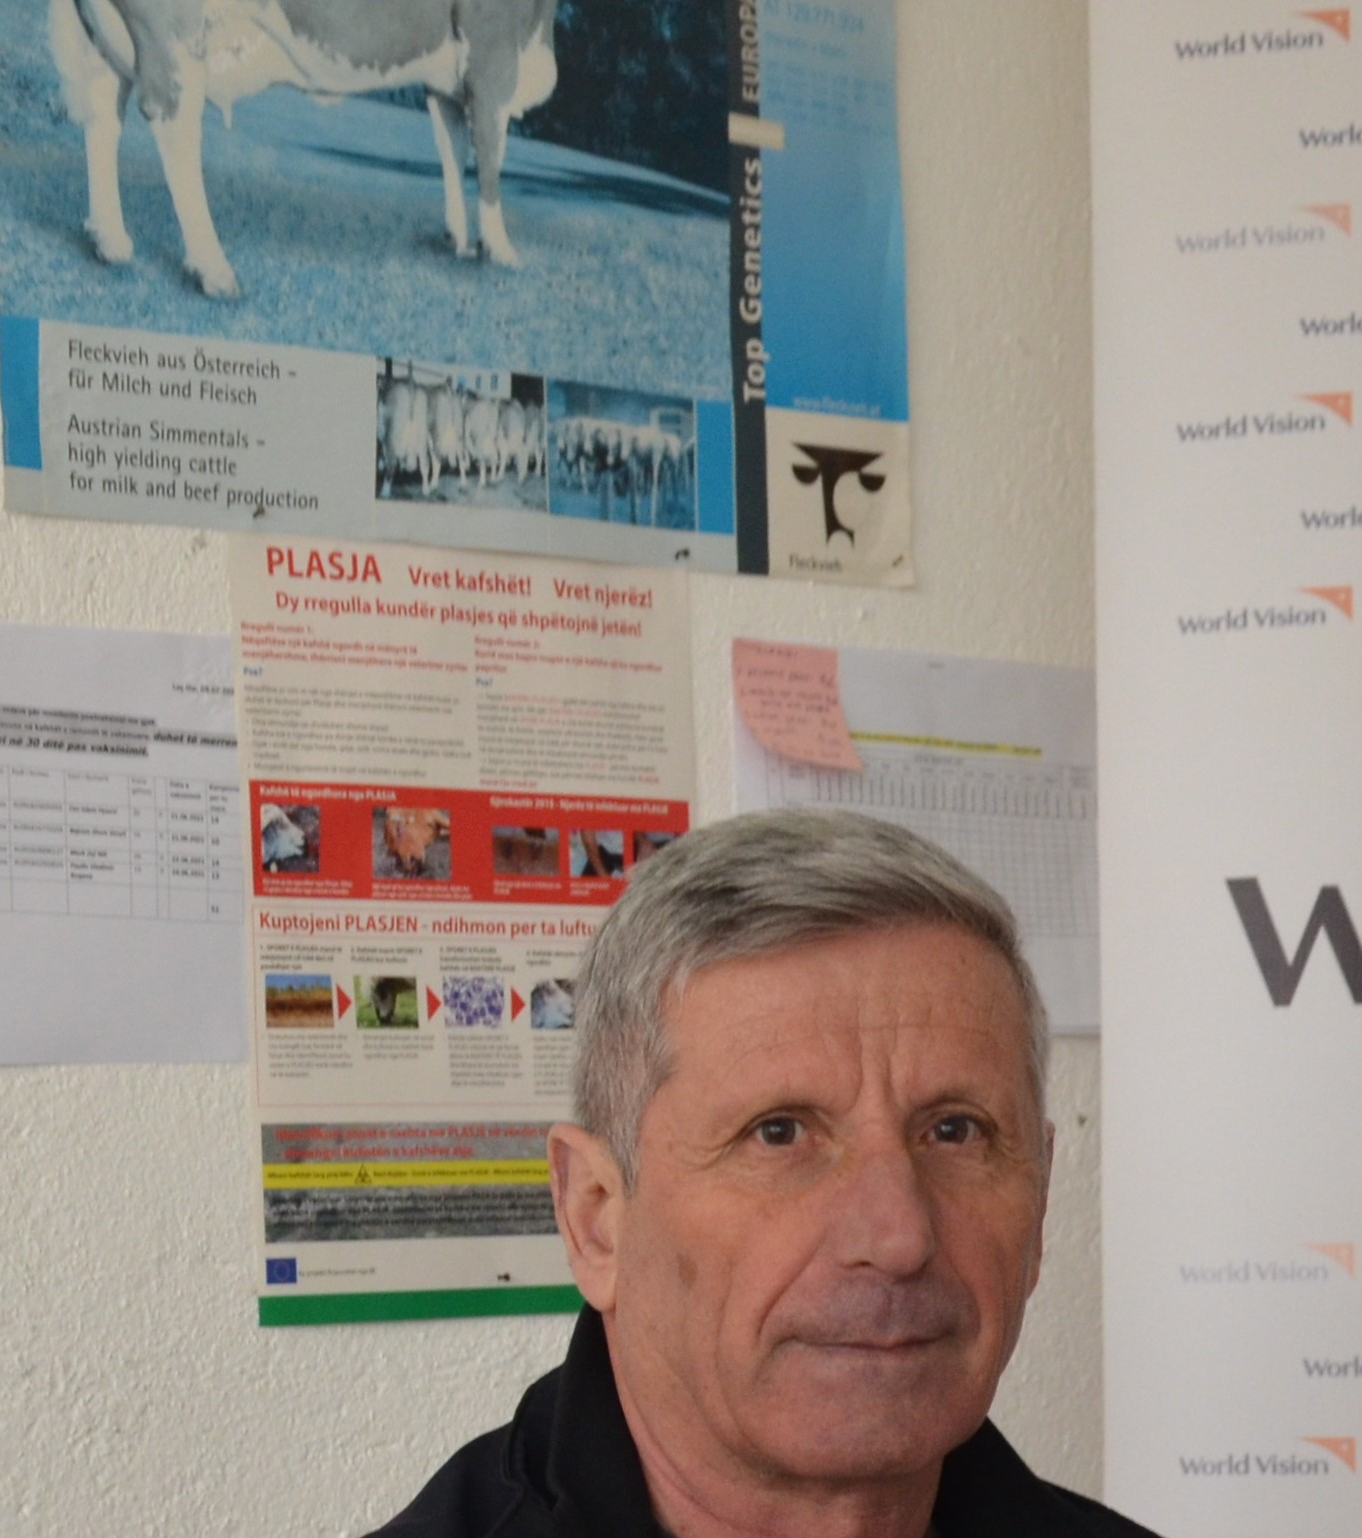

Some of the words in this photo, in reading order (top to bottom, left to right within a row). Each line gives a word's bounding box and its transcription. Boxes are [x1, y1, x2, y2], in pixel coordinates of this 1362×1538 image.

[740, 0, 760, 103] EUROP
[1175, 32, 1246, 60] World
[1251, 30, 1324, 52] Vision
[739, 157, 763, 325] Genetics
[68, 338, 149, 367] Fleckvieh
[157, 353, 186, 371] aus
[193, 349, 280, 380] Österreich
[743, 337, 771, 404] Top
[68, 368, 94, 390] für
[102, 371, 151, 396] Milch
[159, 380, 192, 399] und
[200, 380, 257, 406] Fleisch
[67, 413, 142, 439] Austrian
[149, 420, 249, 449] Simmentals
[68, 442, 106, 468] high
[114, 447, 181, 476] yielding
[189, 456, 237, 476] cattle
[69, 470, 94, 492] for
[102, 475, 138, 495] milk
[145, 479, 176, 499] and
[184, 480, 220, 502] beef
[226, 488, 319, 510] production
[267, 547, 382, 583] PLASJA
[408, 566, 450, 589] Vret
[455, 569, 531, 595] kafshët!
[553, 578, 590, 601] Vret
[594, 586, 652, 608] njerëz!
[789, 555, 842, 572] Fleckvieh
[276, 591, 299, 614] Dy
[304, 596, 372, 617] rregulla
[375, 598, 436, 619] kundër
[440, 604, 494, 626] plasjes
[497, 611, 517, 629] që
[521, 610, 598, 634] shpëtojnë
[602, 617, 642, 637] jetën!
[1177, 607, 1248, 635] World
[1253, 606, 1327, 628] Vision
[26, 736, 41, 748] 30
[259, 912, 340, 935] Kuptojeni
[345, 914, 418, 933] PLASJEN
[432, 916, 506, 934] ndihmon
[510, 923, 537, 939] per
[541, 921, 556, 936] ta
[1179, 1453, 1250, 1476] World
[1255, 1454, 1330, 1476] Vision
